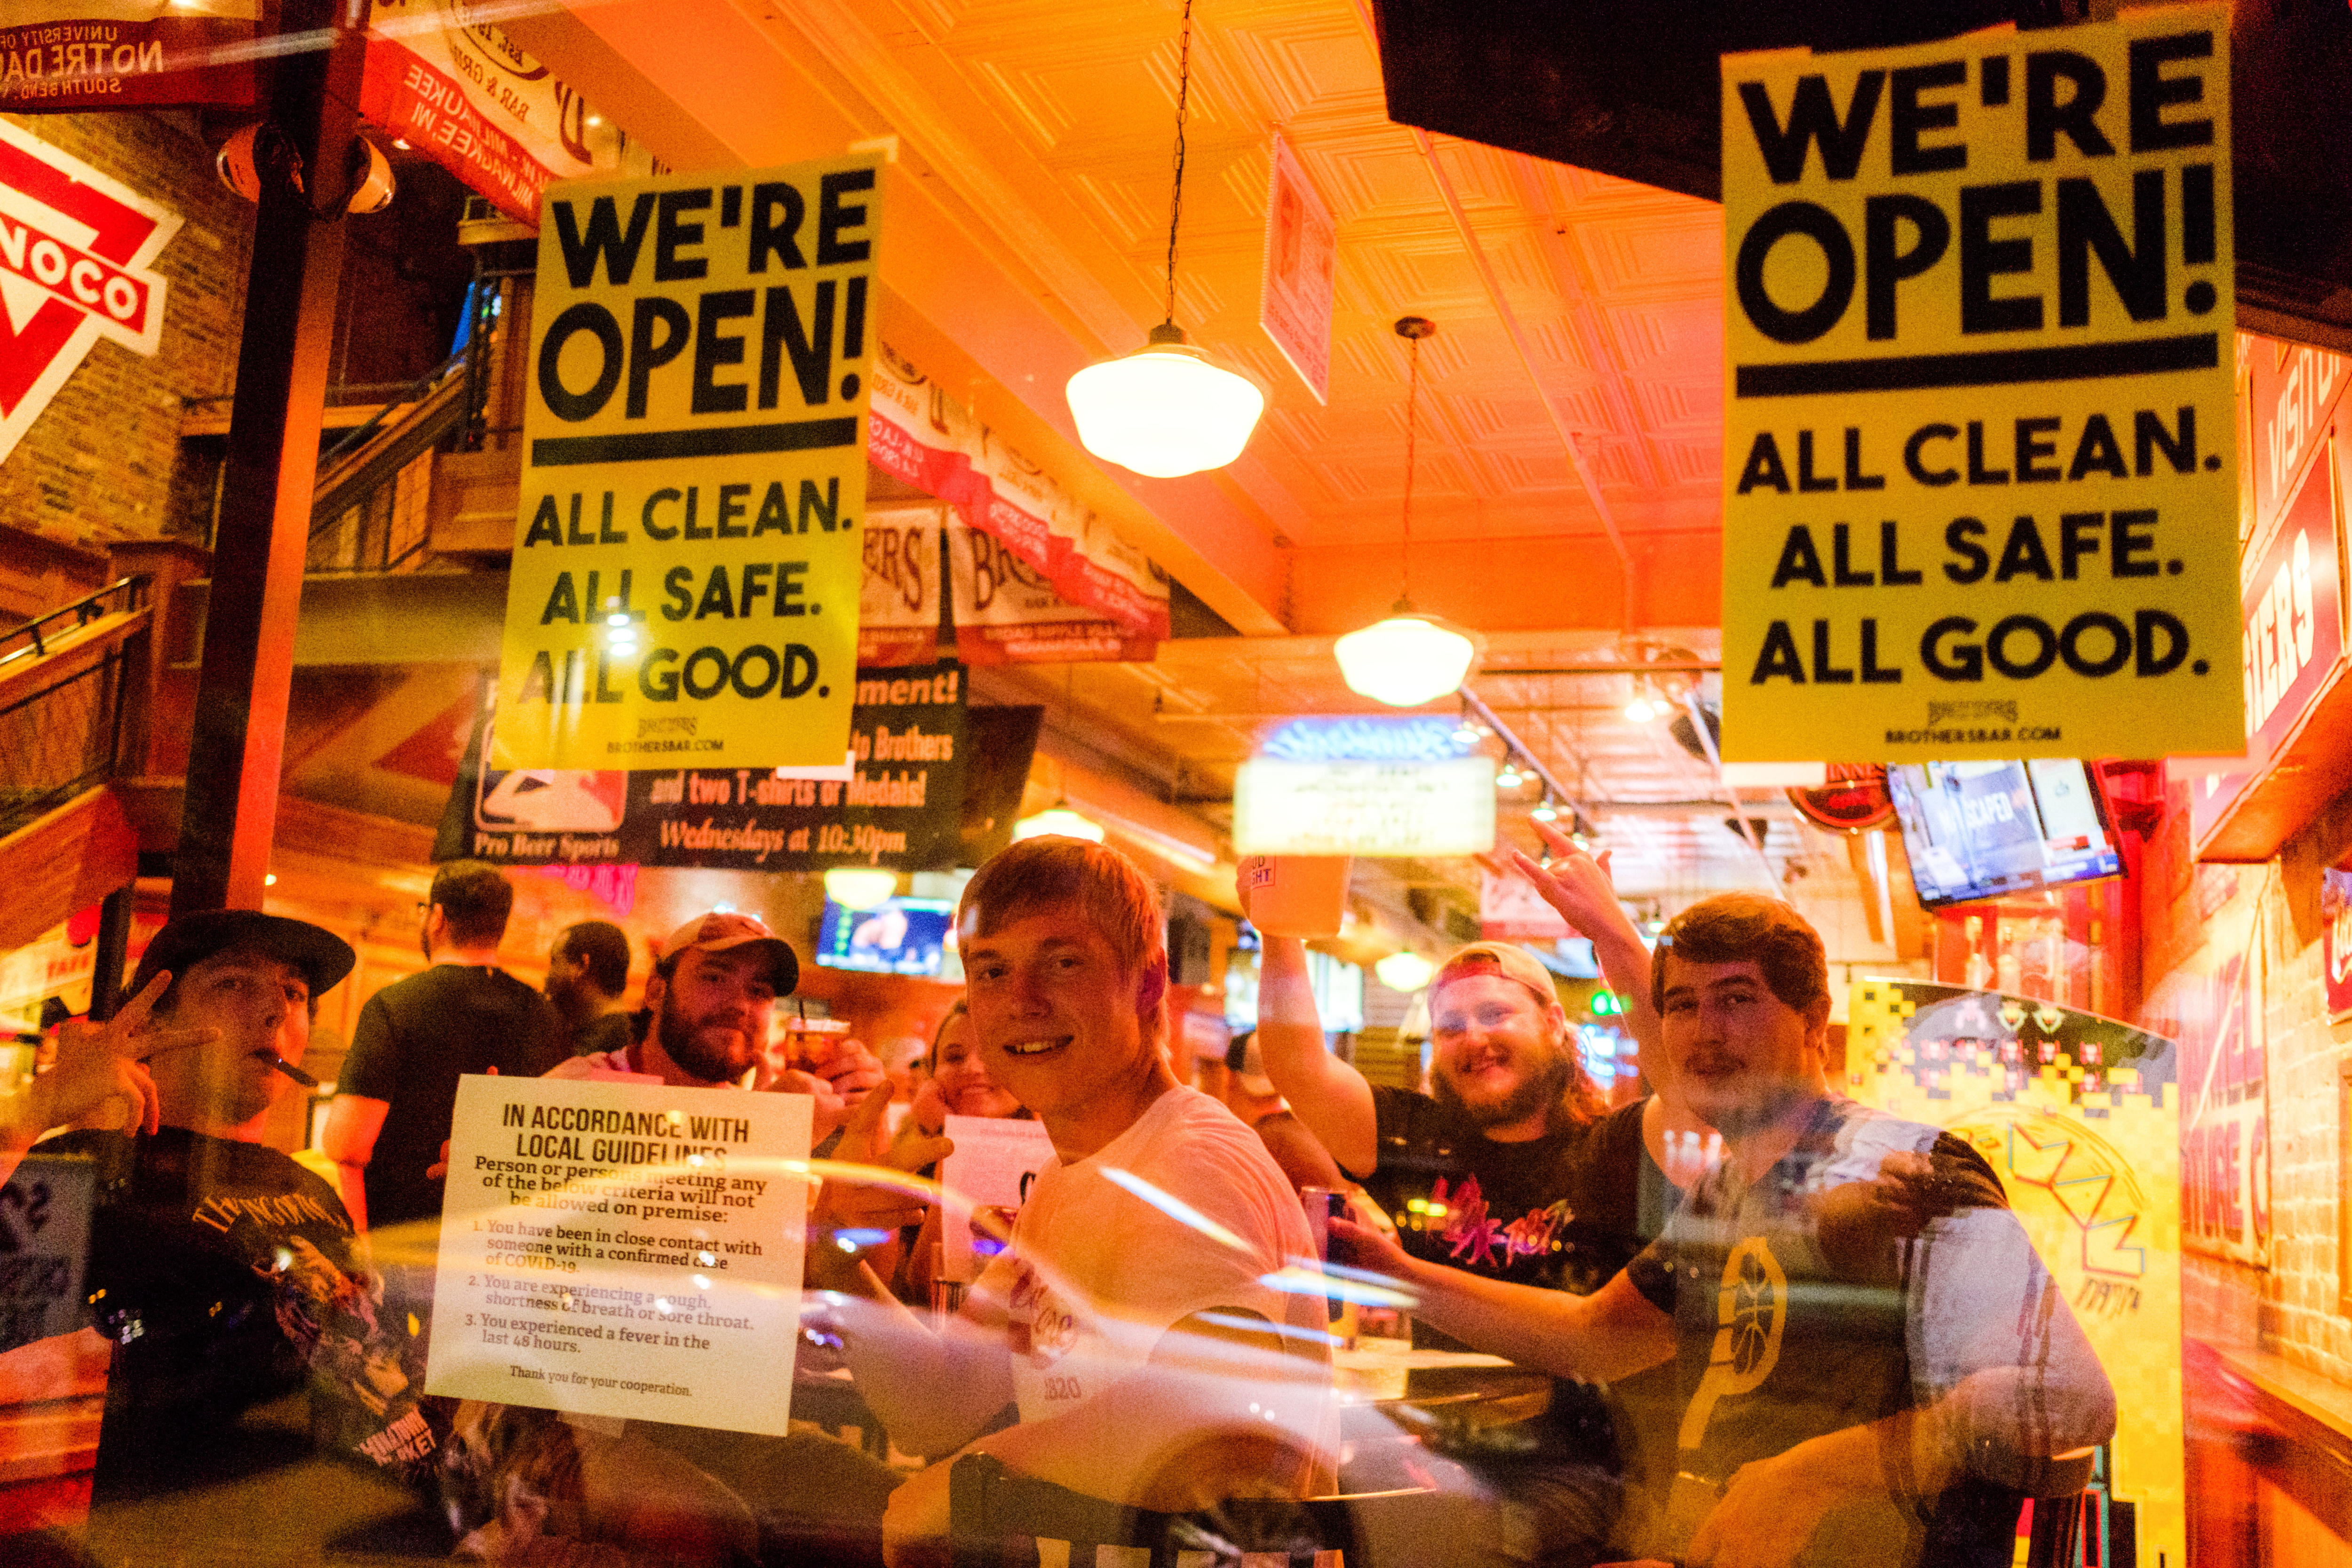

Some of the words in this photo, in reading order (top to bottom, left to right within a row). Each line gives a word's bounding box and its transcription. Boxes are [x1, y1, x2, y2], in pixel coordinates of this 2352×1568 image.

[1737, 30, 2215, 186] WE'RE
[551, 167, 876, 289] WE'RE
[1735, 162, 2217, 345] OPEN!
[537, 275, 868, 422] OPEN!
[1736, 427, 1886, 494] ALL
[1902, 405, 2222, 487] CLEAN.
[523, 491, 628, 548] ALL
[641, 476, 853, 541] CLEAN.
[1770, 520, 1923, 589] ALL
[1942, 507, 2184, 585] SAFE.
[540, 568, 646, 625] ALL
[660, 561, 822, 621] SAFE.
[1750, 618, 1902, 685] ALL
[1919, 608, 2209, 682] GOOD.
[518, 650, 623, 704] ALL
[637, 643, 831, 702] GOOD.
[874, 725, 953, 761] Brothers
[651, 768, 684, 804] and
[689, 772, 731, 805] two
[737, 770, 816, 806] T-shirts
[474, 831, 508, 857] Pro
[660, 817, 784, 863] Wednesdays
[788, 827, 810, 852] at
[503, 1104, 525, 1127] IN
[531, 1106, 682, 1138] ACCORDANCE
[690, 1115, 750, 1143] WITH
[516, 1133, 585, 1161] LOCAL
[475, 1155, 537, 1174] Person
[542, 1164, 562, 1176] or
[731, 1178, 768, 1196] any
[482, 1173, 504, 1187] of
[507, 1175, 537, 1190] the
[541, 1177, 596, 1195] below
[602, 1185, 675, 1202] criteria
[681, 1188, 717, 1204] will
[723, 1194, 756, 1208] not
[510, 1191, 532, 1206] be
[536, 1194, 609, 1213] allowed
[613, 1203, 637, 1215] on
[642, 1205, 729, 1223] premise:
[487, 1219, 514, 1234] You
[518, 1221, 553, 1238] have
[556, 1224, 593, 1242] been
[596, 1228, 611, 1243] in
[615, 1230, 656, 1247] close
[659, 1236, 721, 1252] contact
[724, 1240, 763, 1256] with
[487, 1238, 553, 1254] someone
[556, 1242, 592, 1258] with
[595, 1248, 604, 1259] a
[608, 1248, 689, 1266] confirmed
[693, 1256, 728, 1269] cse
[486, 1252, 503, 1266] of
[468, 1275, 480, 1287] 2.
[484, 1274, 510, 1289] You
[514, 1280, 538, 1292] are
[541, 1282, 643, 1306] experiencing
[645, 1293, 655, 1304] a
[485, 1291, 558, 1310] shortness
[582, 1298, 634, 1318] breath
[638, 1308, 655, 1320] or
[659, 1311, 693, 1324] sore
[697, 1312, 755, 1330] throat.
[465, 1313, 477, 1326] 3.
[480, 1313, 507, 1329] You
[510, 1320, 604, 1339] experienced
[606, 1329, 615, 1340] a
[619, 1326, 660, 1345] fever
[664, 1331, 680, 1347] in
[683, 1334, 710, 1350] the
[482, 1329, 509, 1345] last
[513, 1335, 530, 1348] 48
[533, 1334, 581, 1353] hours.
[510, 1364, 545, 1380] Thank
[548, 1372, 569, 1384] you
[571, 1371, 588, 1385] for
[590, 1376, 618, 1389] your
[620, 1379, 692, 1397] cooperation.
